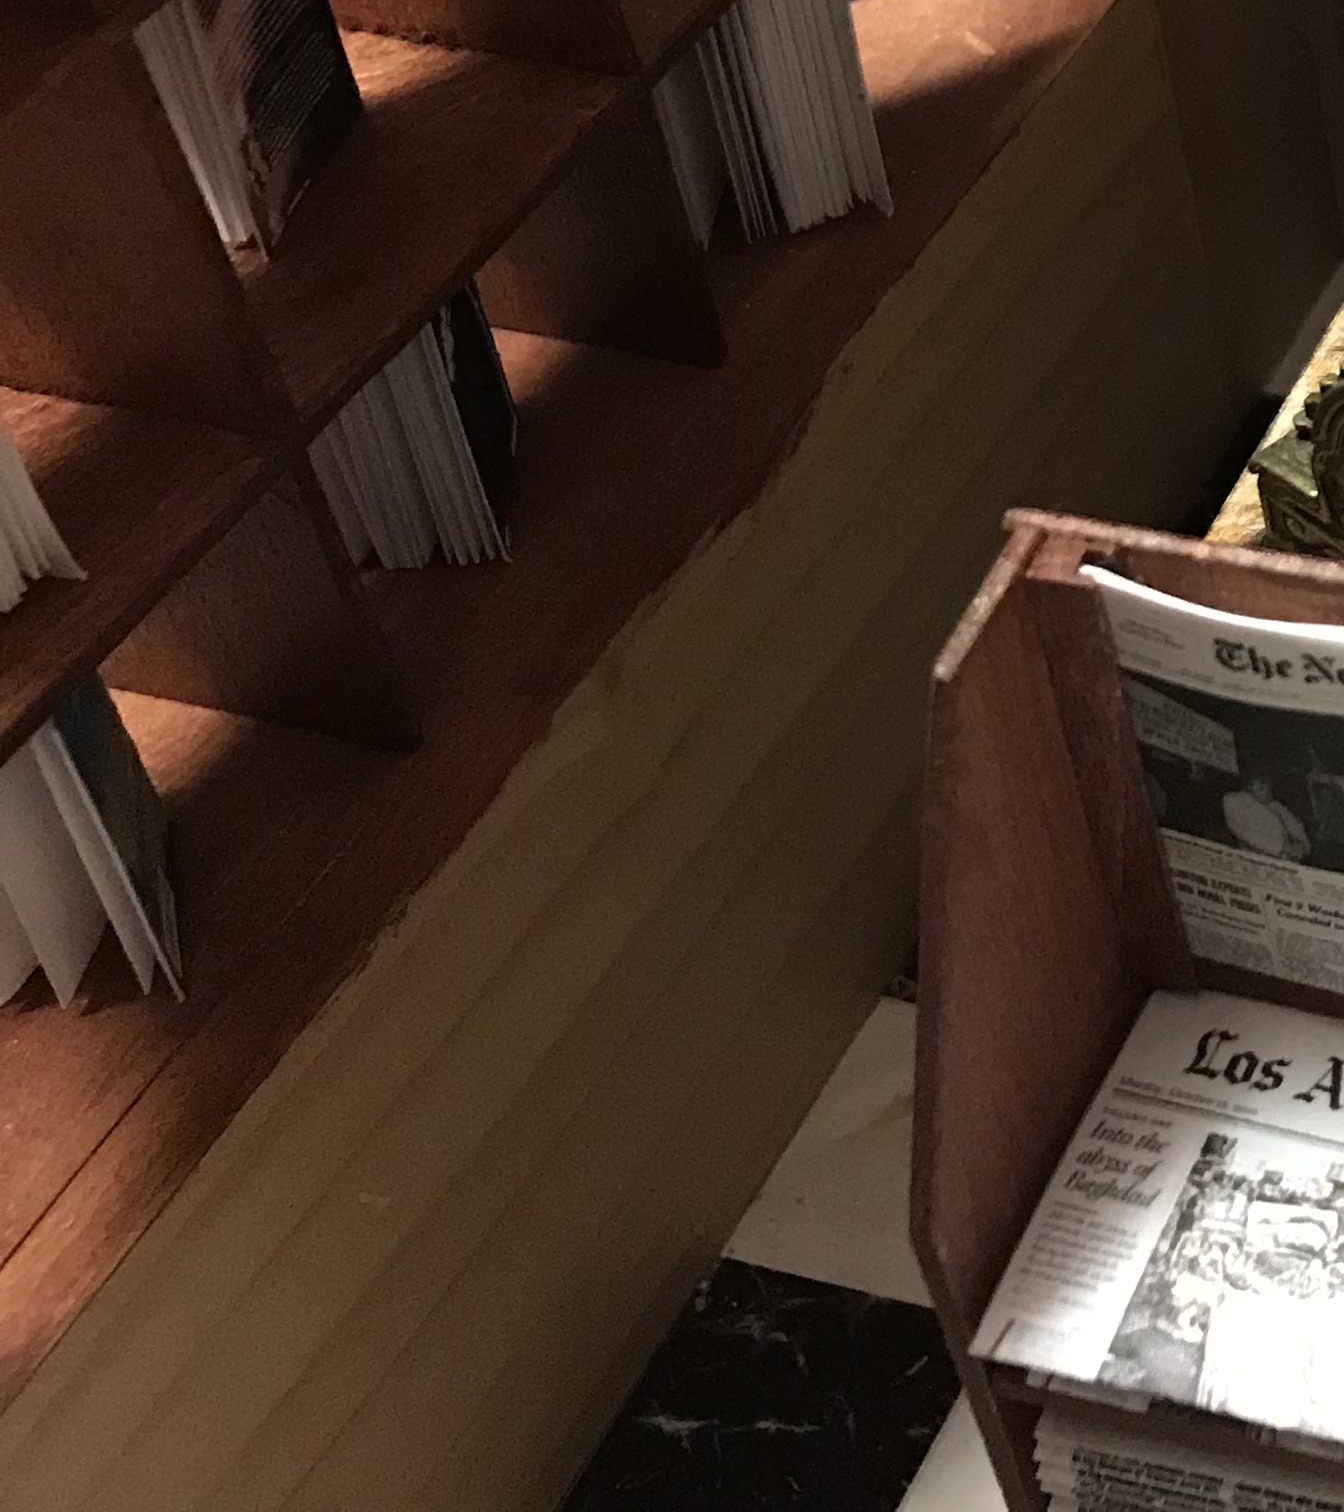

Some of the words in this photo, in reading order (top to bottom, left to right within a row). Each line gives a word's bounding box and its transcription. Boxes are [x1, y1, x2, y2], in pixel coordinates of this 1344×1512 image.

[1214, 637, 1294, 679] The
[1184, 1027, 1286, 1091] Los
[1091, 1120, 1134, 1145] Into
[1134, 1131, 1170, 1153] the
